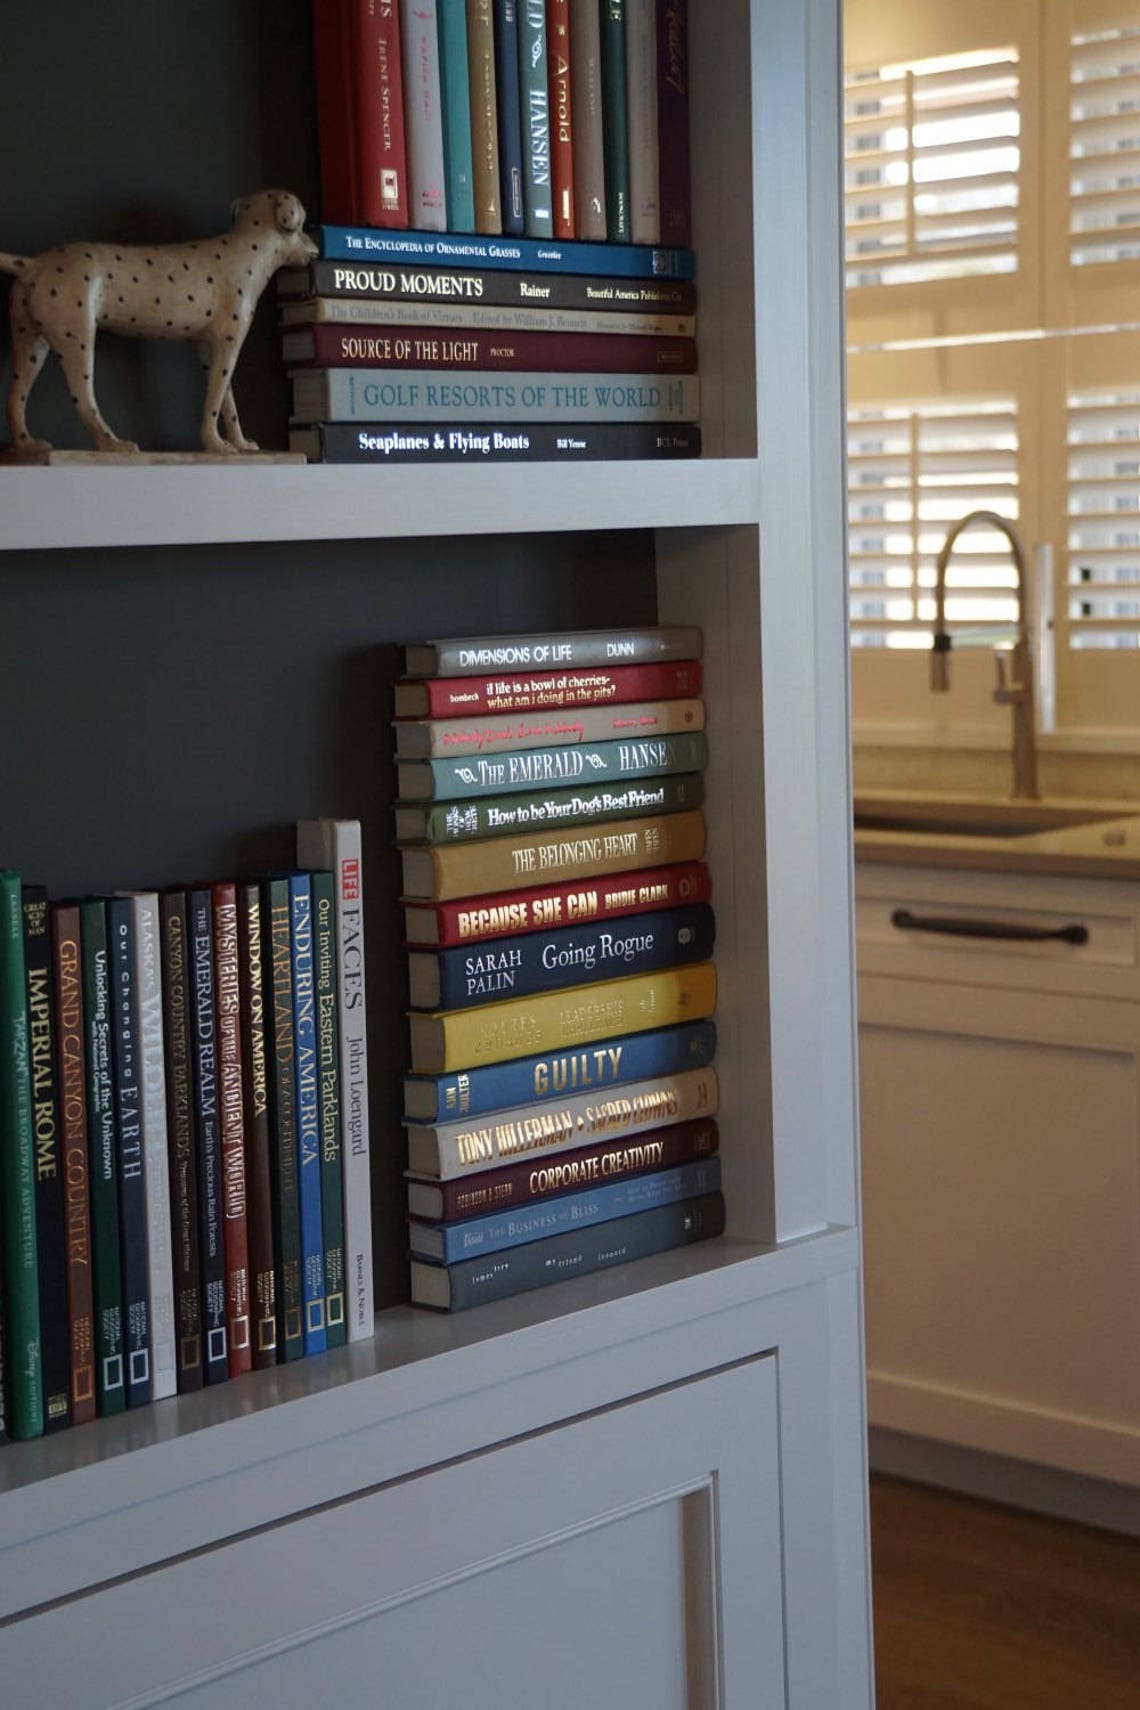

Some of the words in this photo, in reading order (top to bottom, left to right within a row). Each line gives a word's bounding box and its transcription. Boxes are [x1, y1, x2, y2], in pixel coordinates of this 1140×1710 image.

[381, 86, 392, 152] SPENCER
[554, 54, 571, 143] Arnold
[529, 89, 550, 186] HANSEN
[346, 236, 363, 249] THE
[365, 237, 423, 253] ENCYCLOPEDIA
[424, 243, 435, 254] OF
[436, 242, 487, 257] ORNAMENTAL
[489, 245, 521, 259] GRASSES
[334, 268, 396, 292] PROUD
[400, 273, 483, 297] MOMENTS
[520, 282, 551, 299] Rainer
[587, 286, 613, 300] Beautiful
[614, 288, 640, 301] America
[331, 305, 349, 318] The
[397, 307, 419, 320] Book
[420, 308, 430, 320] of
[513, 311, 548, 327] William
[341, 338, 391, 359] SOURCE
[395, 339, 411, 360] OF
[414, 341, 439, 361] THE
[442, 341, 479, 361] LIGHT
[363, 384, 419, 406] GOLF
[427, 384, 516, 408] RESORTS
[521, 385, 547, 408] OF
[551, 386, 591, 408] THE
[594, 386, 662, 408] WORLD
[359, 432, 430, 454] Seaplanes
[433, 432, 445, 449] &
[450, 432, 490, 454] Flying
[493, 432, 530, 450] Boats
[459, 647, 530, 668] DIMENSIONS
[533, 644, 549, 662] OF
[552, 644, 573, 661] LIFE
[606, 641, 635, 658] DUNN
[486, 682, 494, 695] if
[495, 681, 511, 695] life
[512, 680, 522, 693] is
[523, 683, 531, 692] a
[531, 678, 556, 692] bowl
[556, 676, 567, 689] of
[487, 695, 513, 709] what
[514, 696, 530, 706] am
[537, 691, 564, 704] doing
[565, 687, 576, 700] in
[576, 686, 591, 699] the
[594, 684, 617, 702] pits?
[478, 760, 505, 786] THE
[509, 750, 583, 784] EMERALD
[488, 807, 516, 827] How
[517, 807, 528, 823] to
[530, 804, 545, 821] be
[545, 801, 573, 819] Your
[602, 792, 628, 812] Best
[628, 787, 664, 808] Friend
[512, 847, 536, 874] THE
[539, 838, 602, 870] BELONGING
[603, 832, 637, 859] HEART
[343, 860, 359, 899] LIFE
[604, 889, 636, 910] BRIDIE
[639, 884, 668, 904] CLARK
[197, 908, 207, 930] THE
[319, 898, 331, 926] Our
[458, 903, 528, 938] BECAUSE
[532, 897, 562, 923] SHE
[567, 891, 598, 919] CAN
[120, 924, 128, 960] Our
[168, 915, 184, 980] CANYON
[217, 903, 240, 1014] MYSTERIES
[248, 904, 262, 990] WINDOW
[293, 894, 315, 1035] ENDURING
[318, 931, 333, 990] Inviting
[342, 907, 363, 1010] FACES
[465, 949, 523, 976] SARAH
[542, 942, 596, 969] Going
[600, 932, 654, 962] Rogue
[60, 940, 80, 1028] GRAND
[95, 951, 108, 1020] Unlocking
[195, 935, 213, 1038] EMERALD
[271, 906, 295, 1063] HEARTLAND
[466, 970, 516, 996] PALIN
[28, 967, 54, 1098] IMPERIAL
[121, 971, 133, 1077] Changing
[170, 985, 187, 1059] COUNTRY
[250, 995, 263, 1024] ON
[320, 993, 336, 1066] Eastern
[12, 1009, 30, 1072] TARZAN
[99, 1021, 109, 1068] Secrets
[346, 1035, 364, 1076] John
[63, 1034, 83, 1140] CANYON
[101, 1072, 112, 1085] of
[199, 1043, 216, 1117] REALM
[251, 1029, 267, 1118] AMERICA
[534, 1047, 623, 1095] GUILTY
[102, 1087, 112, 1110] the
[173, 1064, 190, 1159] PARKLANDS
[222, 1062, 244, 1144] ANCIENT
[300, 1046, 320, 1168] AMERICA
[322, 1069, 341, 1162] Parklands
[347, 1080, 368, 1157] Loengard
[18, 1108, 31, 1184] BROADWAY
[35, 1099, 58, 1182] ROME
[101, 1111, 114, 1180] Unknown
[120, 1085, 141, 1180] EARTH
[456, 1129, 494, 1166] TONY
[496, 1110, 573, 1157] HILLERMAN
[206, 1155, 216, 1197] Precious
[225, 1146, 246, 1219] WORLD
[529, 1157, 599, 1194] CORPORATE
[601, 1142, 664, 1177] CREATIVITY
[22, 1187, 35, 1269] ADVENTURE
[66, 1148, 89, 1265] COUNTRY
[207, 1198, 217, 1221] Rain
[508, 1215, 558, 1238] BUSINESS
[209, 1222, 218, 1257] Forests
